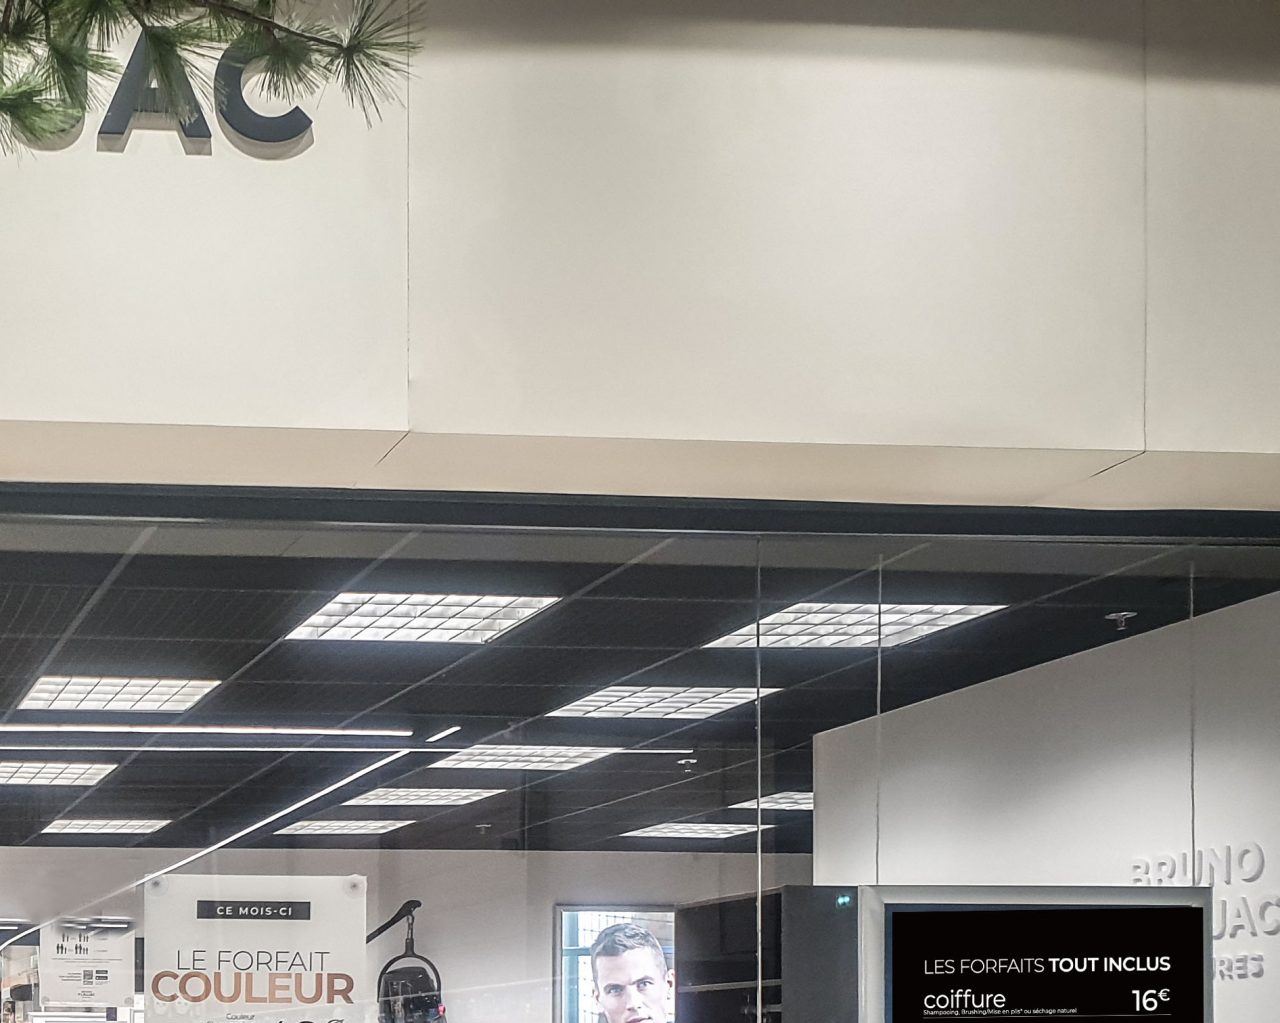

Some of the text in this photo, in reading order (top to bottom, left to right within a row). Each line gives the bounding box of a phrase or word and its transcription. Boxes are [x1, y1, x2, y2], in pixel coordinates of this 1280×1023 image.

[216, 906, 292, 916] CE MOIS-CI
[177, 950, 330, 972] LE FORFAIT
[924, 956, 1171, 974] LES FORFAITS TOUT INCLUS
[151, 970, 354, 1004] COULEUR
[924, 989, 1006, 1009] coiffure
[1132, 988, 1170, 1012] 16€
